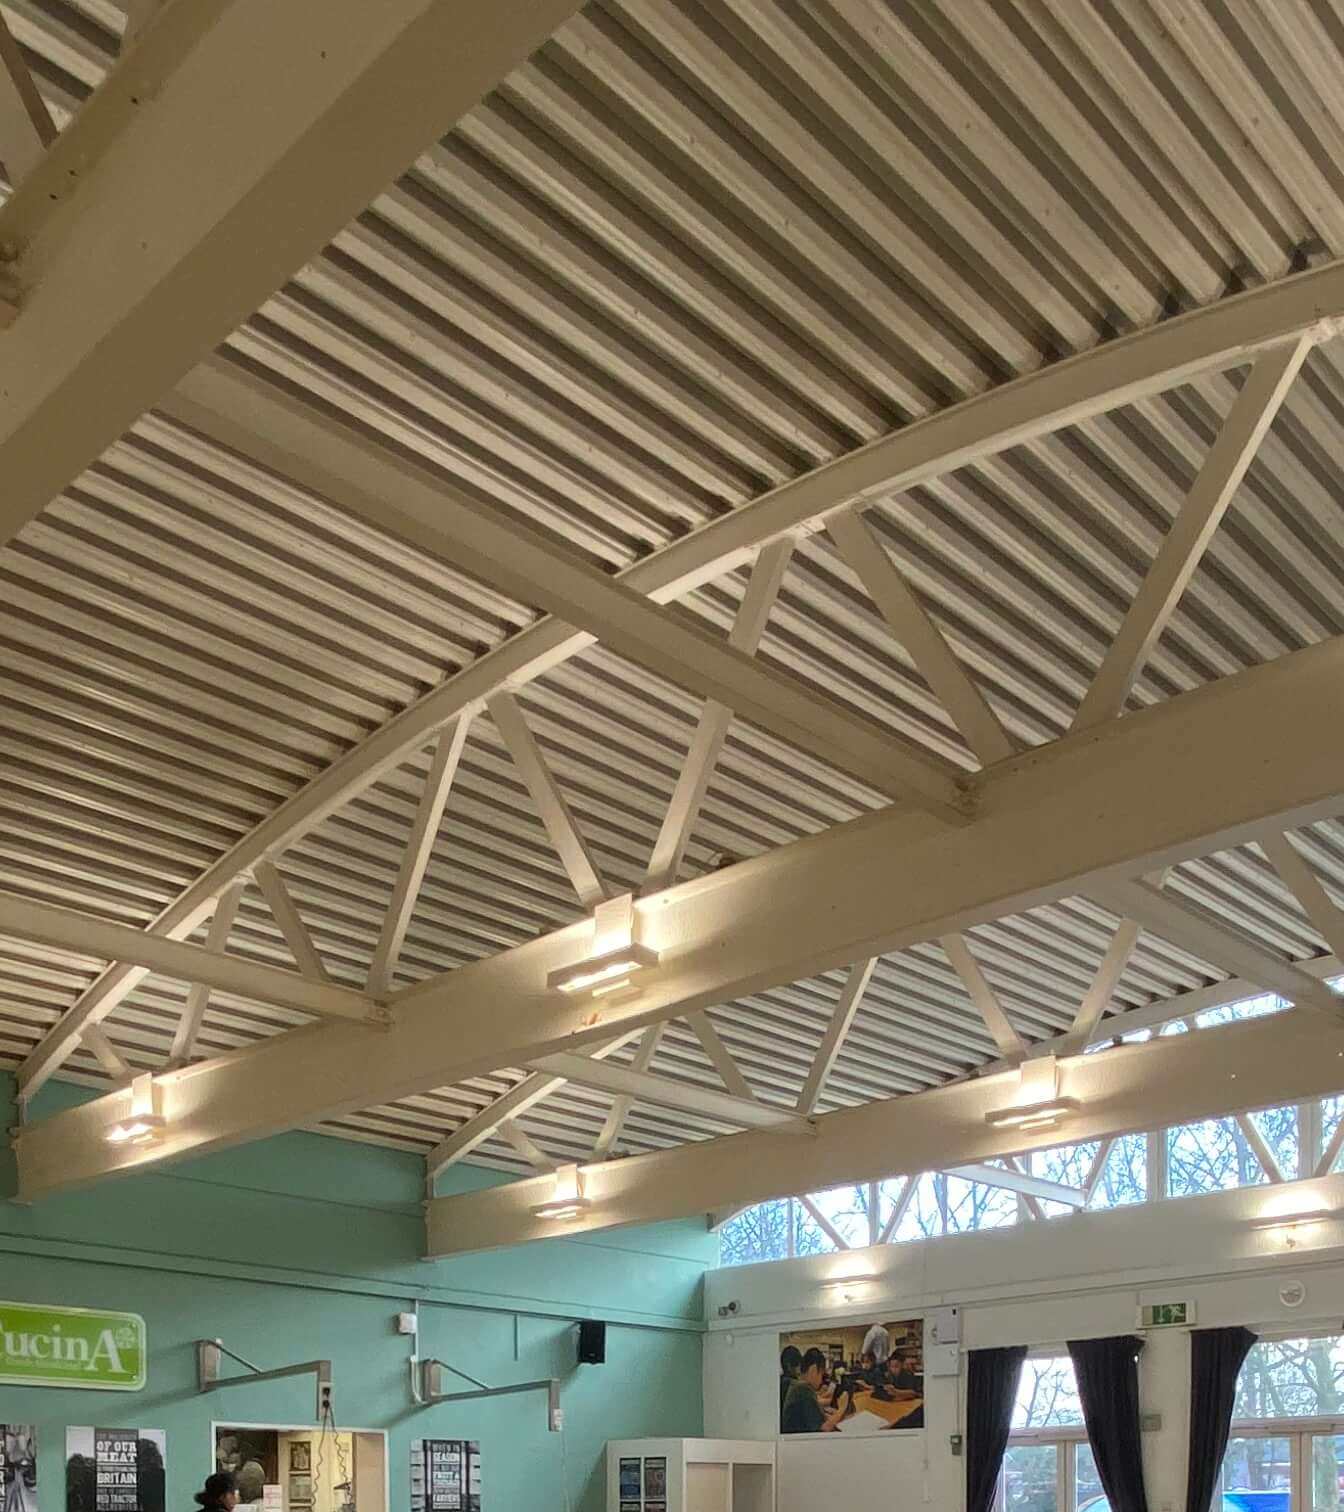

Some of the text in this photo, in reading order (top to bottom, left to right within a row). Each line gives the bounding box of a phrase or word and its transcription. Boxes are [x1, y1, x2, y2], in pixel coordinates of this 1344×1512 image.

[96, 1441, 137, 1452] OF OUR
[96, 1452, 137, 1462] MEAT
[96, 1473, 137, 1484] BRITAIN
